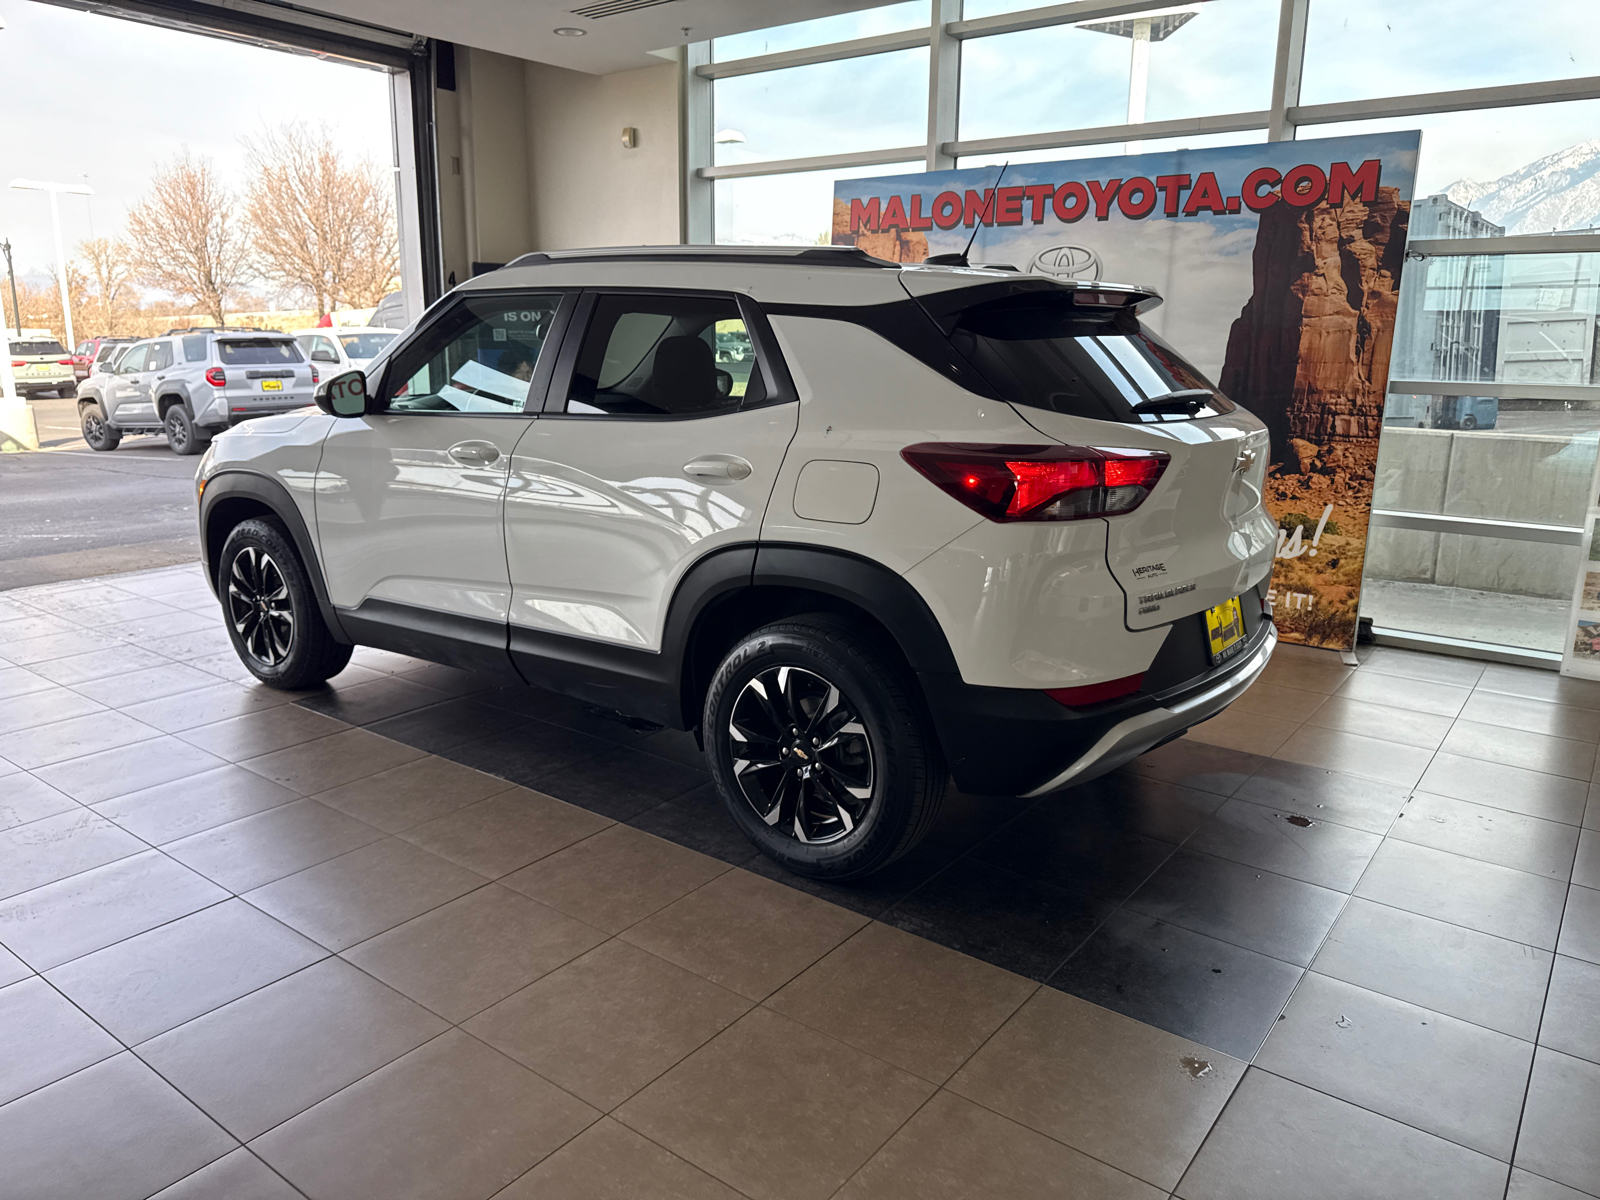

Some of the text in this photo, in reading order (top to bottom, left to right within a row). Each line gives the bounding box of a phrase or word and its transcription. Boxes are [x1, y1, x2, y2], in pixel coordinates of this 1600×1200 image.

[850, 159, 1381, 232] MALONETOYOTA.COM
[504, 311, 518, 322] IS
[1132, 563, 1167, 577] HERITAGE
[1285, 591, 1314, 611] IT!
[707, 648, 750, 729] CONTROL
[756, 641, 767, 654] 2
